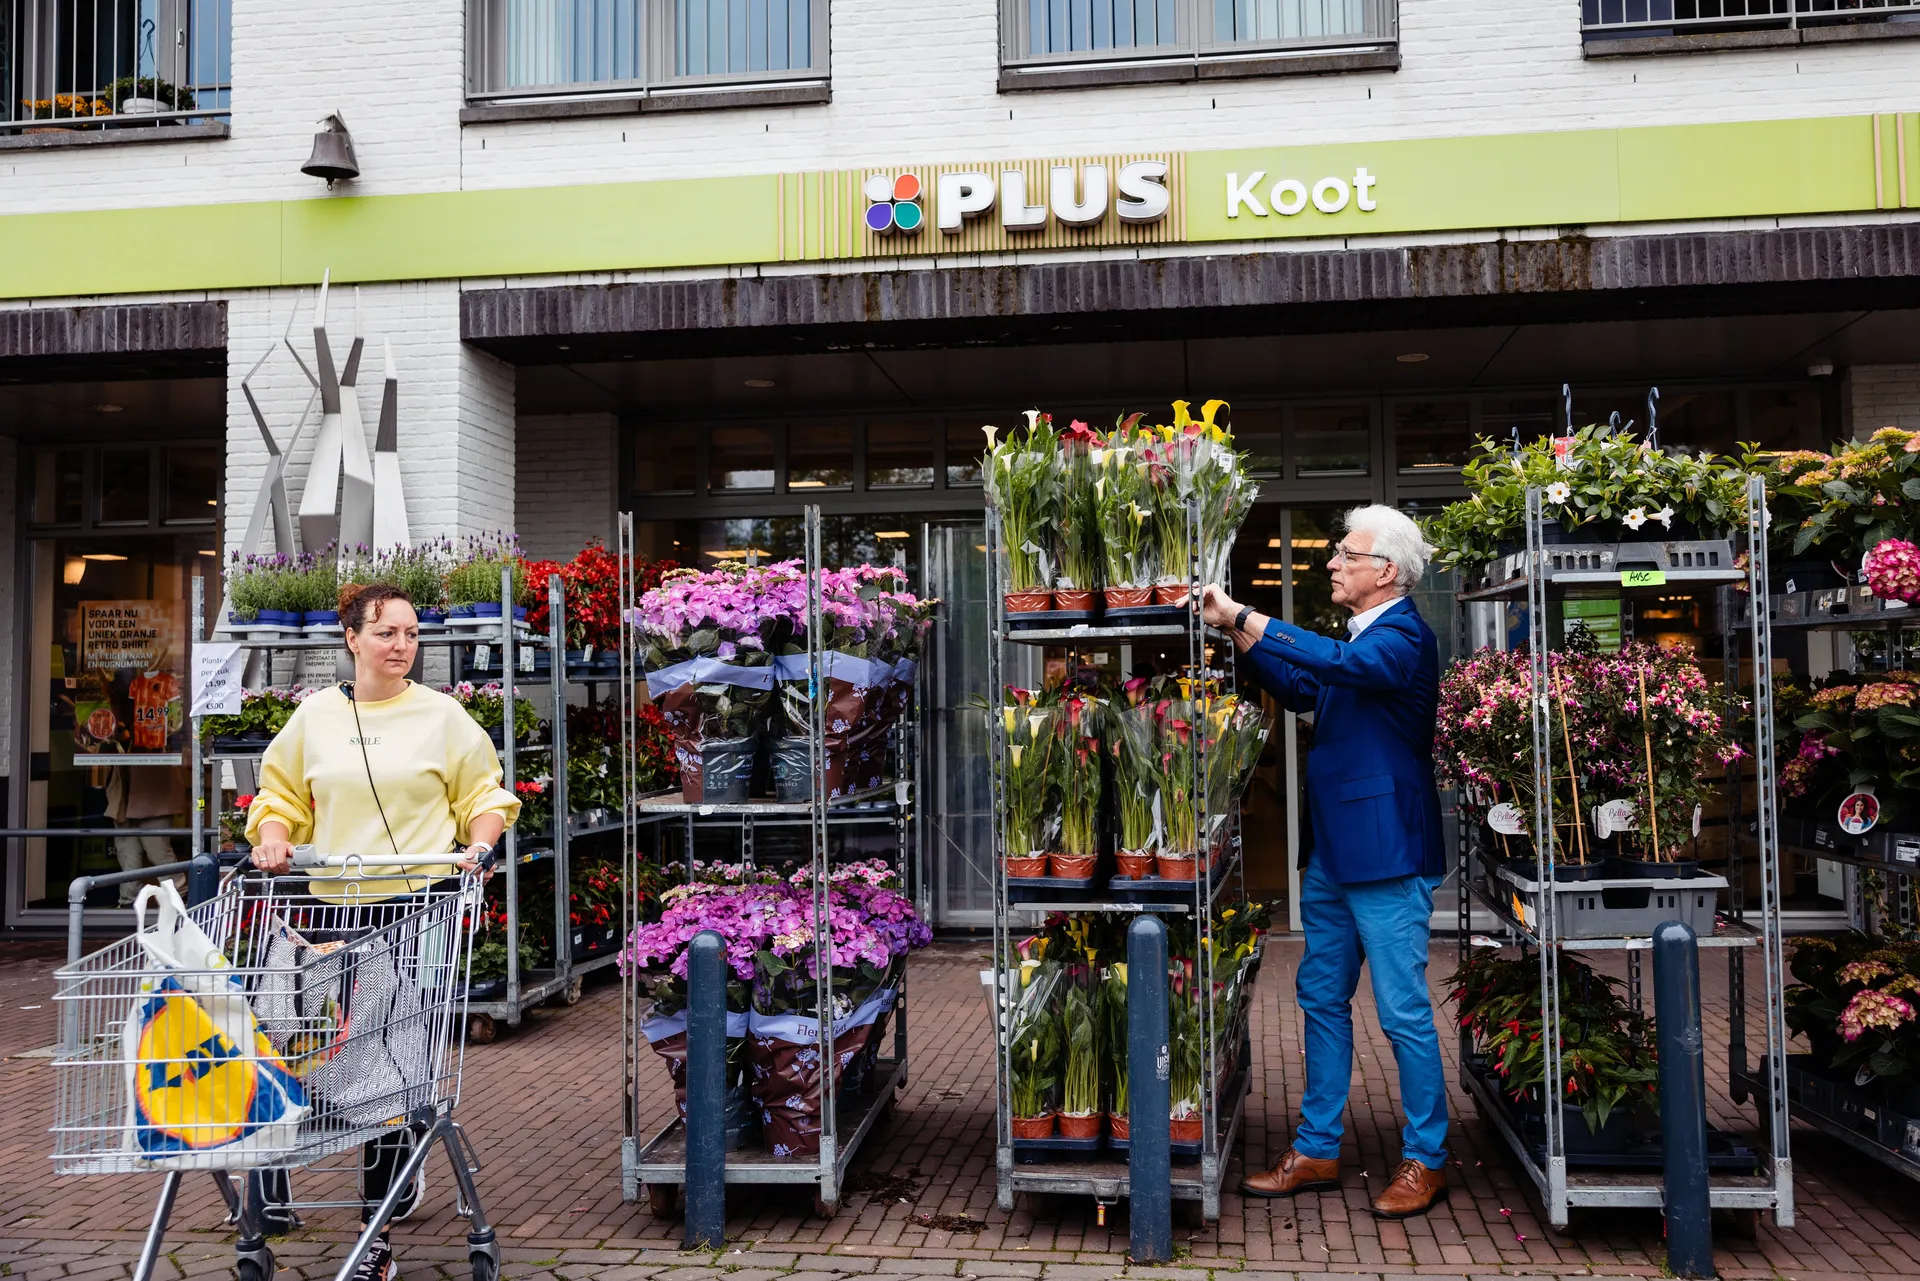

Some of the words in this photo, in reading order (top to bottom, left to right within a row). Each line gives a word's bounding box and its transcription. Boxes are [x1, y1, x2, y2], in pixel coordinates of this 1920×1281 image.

[937, 160, 1169, 233] PLUS
[1226, 167, 1376, 218] Koot
[88, 609, 121, 618] SPAAR
[124, 609, 138, 618] NU
[88, 620, 115, 629] VOOR
[118, 619, 136, 628] EEN
[88, 630, 117, 639] UNIEK
[119, 629, 157, 639] ORANJE
[88, 640, 119, 650] RETRO
[121, 640, 149, 649] SHIRT
[87, 652, 104, 660] MET
[105, 652, 128, 660] EIGEN
[87, 660, 98, 669] EN
[100, 660, 149, 668] RUGNUMMER
[349, 736, 381, 745] SMILE
